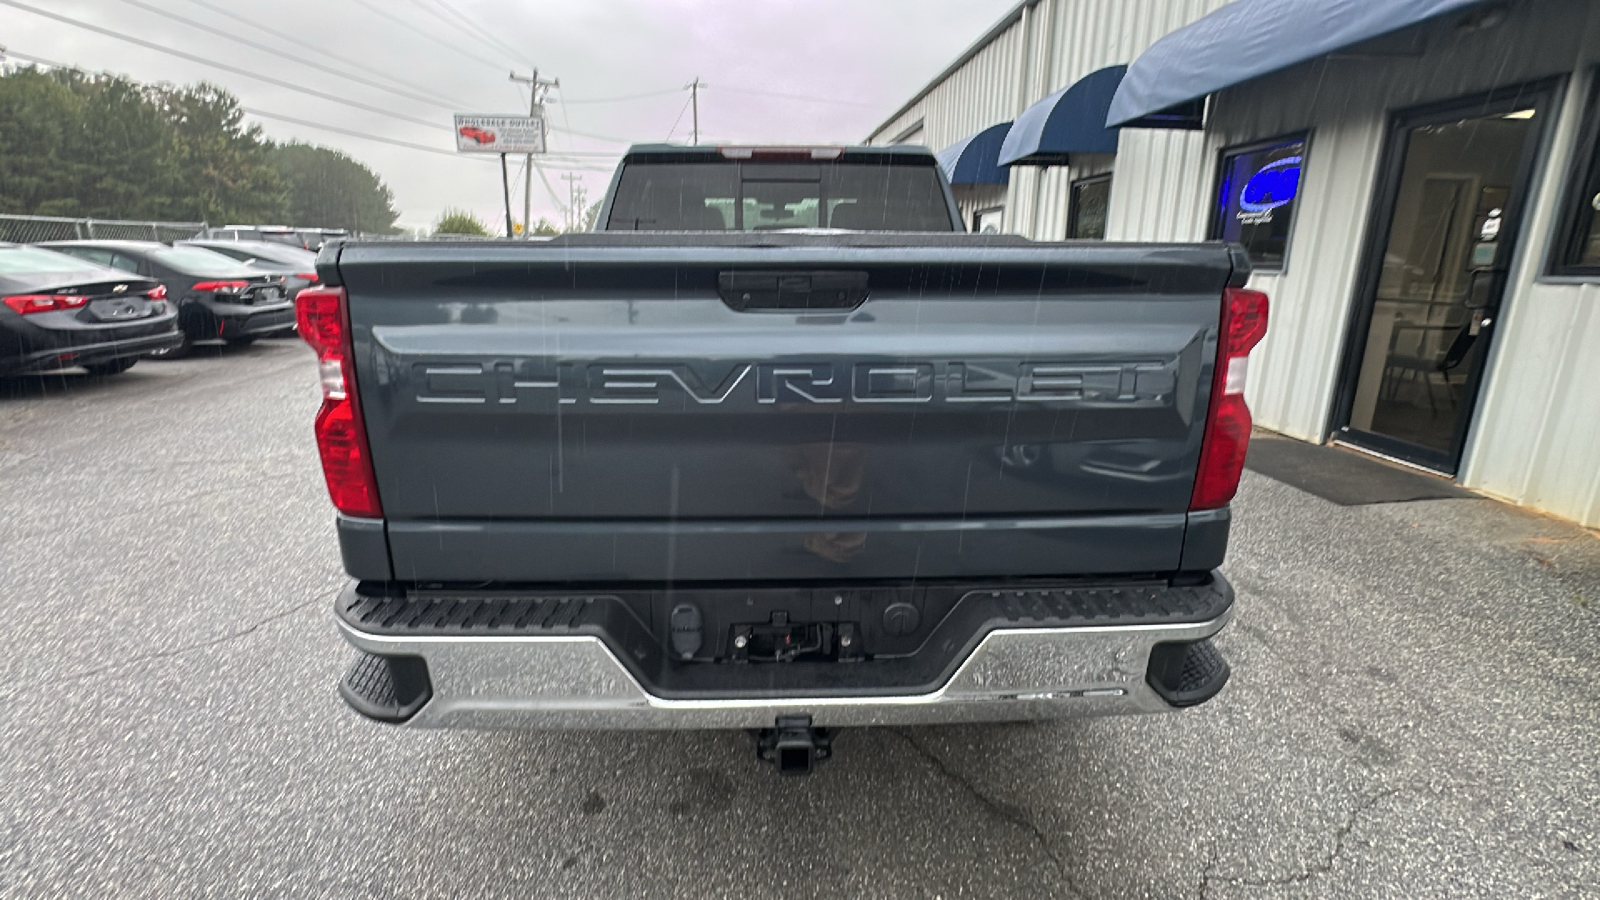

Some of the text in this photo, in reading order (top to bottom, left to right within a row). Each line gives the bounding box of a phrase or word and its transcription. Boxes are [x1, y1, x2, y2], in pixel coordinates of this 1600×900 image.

[458, 117, 540, 128] WHOLESALE OUTLET
[411, 361, 1165, 404] CHEVROLET
